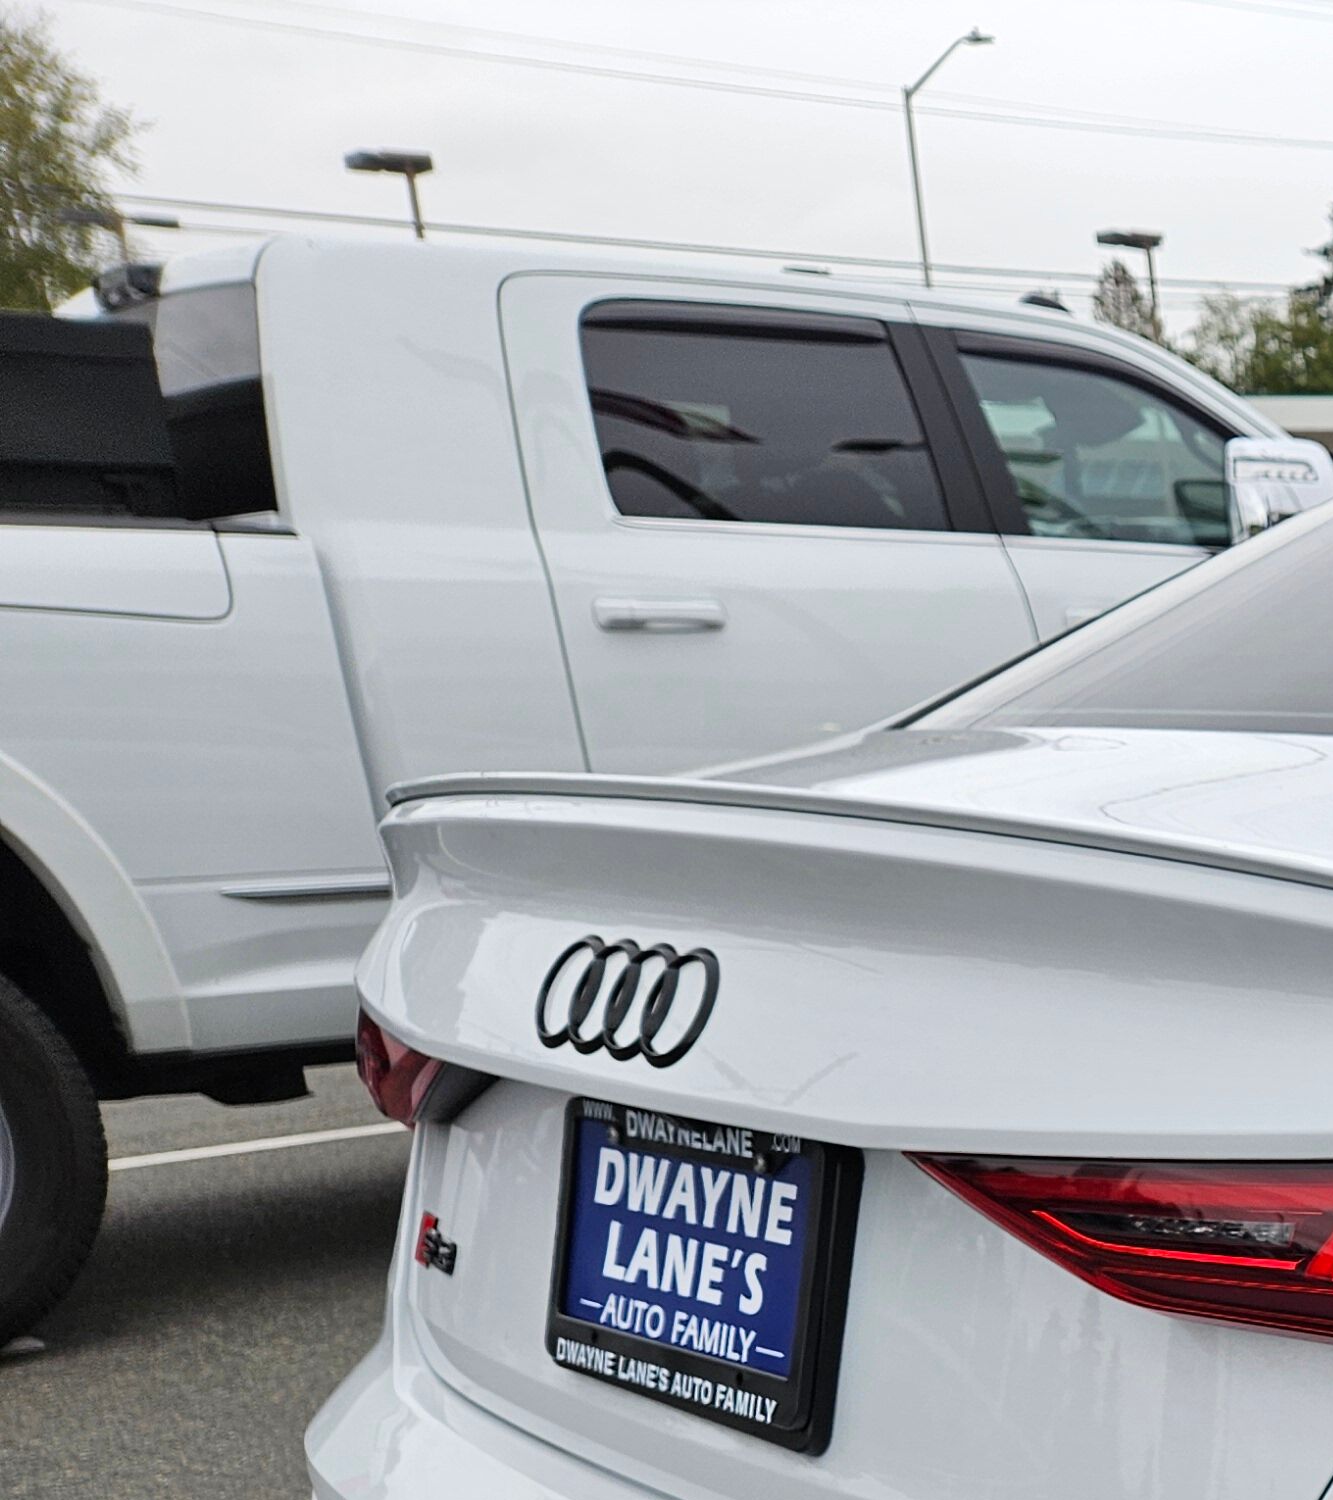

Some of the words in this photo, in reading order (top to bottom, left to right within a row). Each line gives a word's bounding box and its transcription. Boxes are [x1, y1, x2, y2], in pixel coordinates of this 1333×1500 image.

[593, 1147, 799, 1247] DWAYNE
[601, 1220, 769, 1317] LANE'S
[599, 1294, 664, 1339] AUTO
[670, 1312, 758, 1364] FAMILY
[555, 1336, 617, 1377] DWAYNE
[617, 1356, 671, 1394] LANE'S
[670, 1370, 713, 1406] AUTO
[714, 1388, 777, 1425] FAMILY
